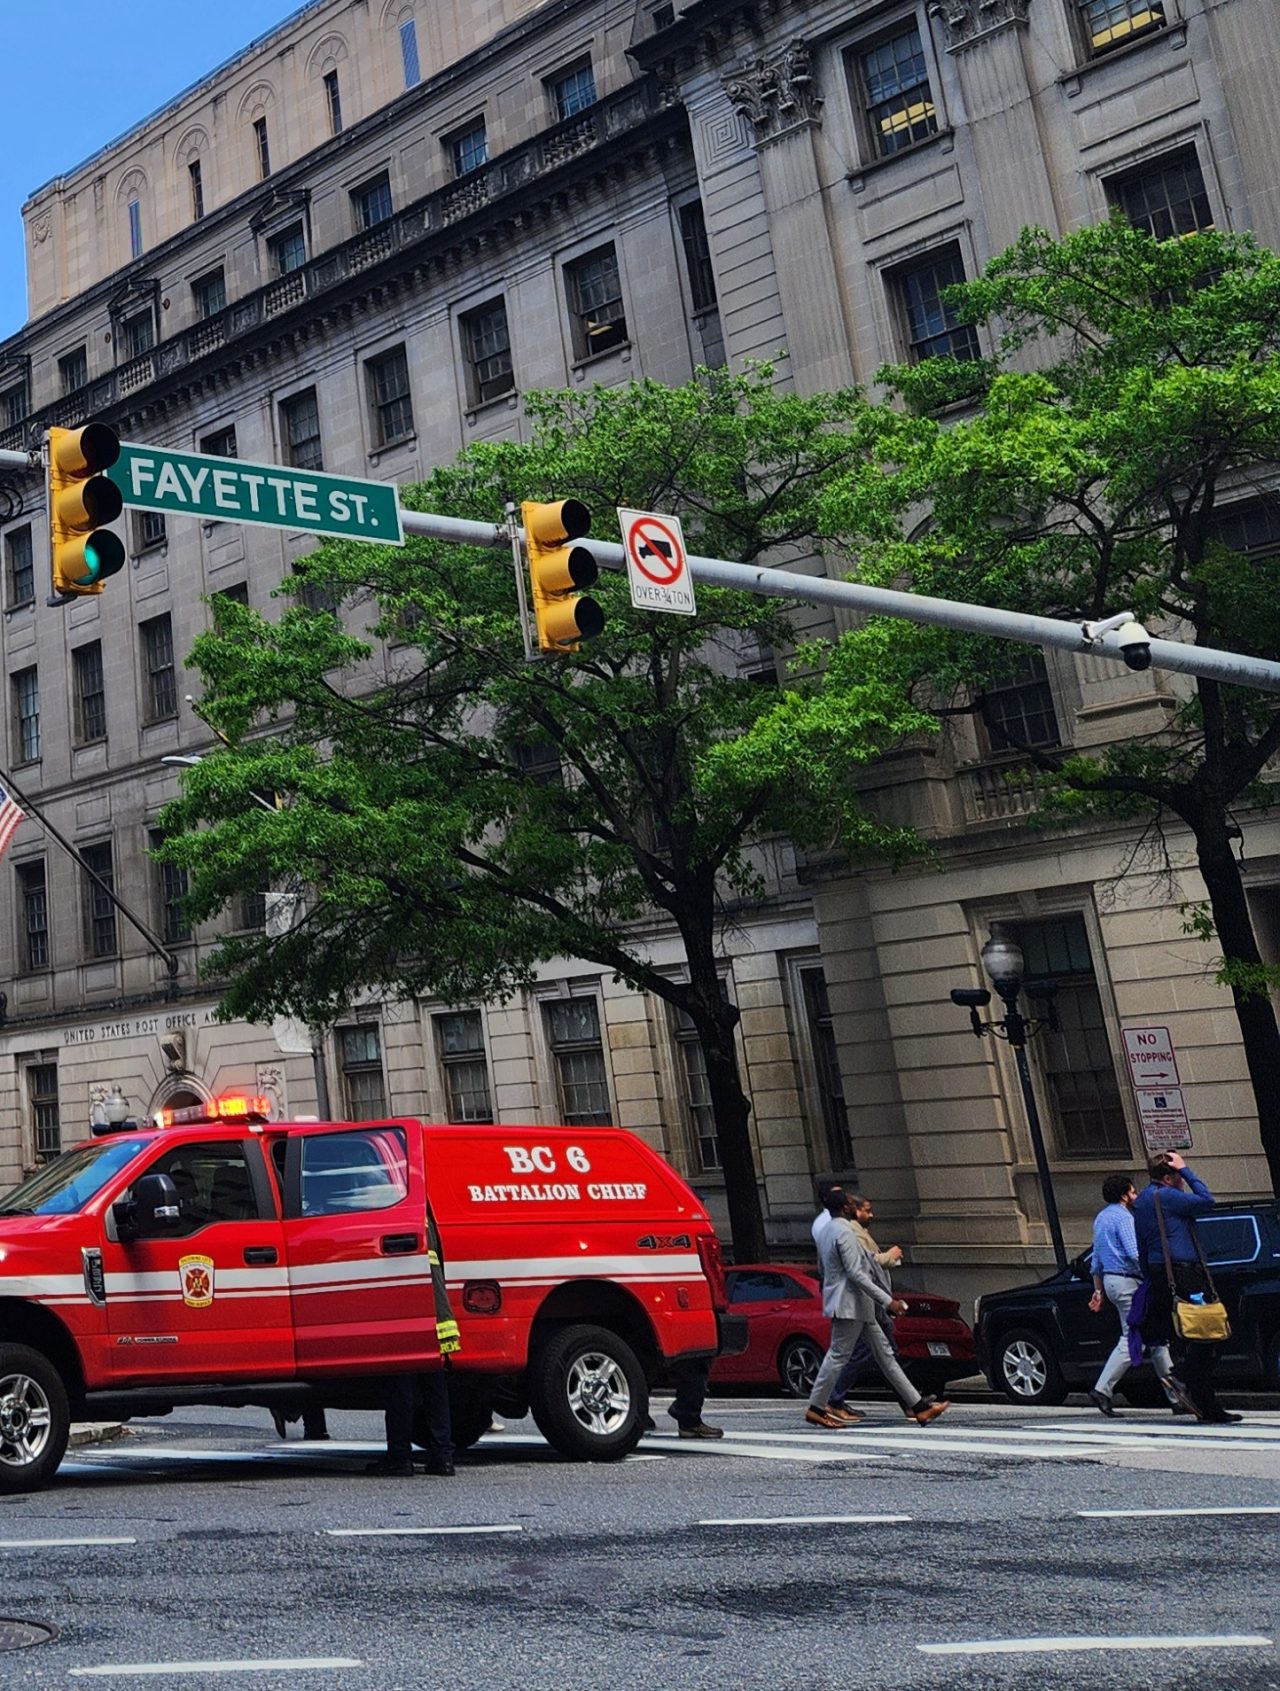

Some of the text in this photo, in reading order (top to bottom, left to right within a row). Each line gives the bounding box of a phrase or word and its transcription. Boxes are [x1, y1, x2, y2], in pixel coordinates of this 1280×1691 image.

[129, 456, 379, 527] FAYETTE ST.
[635, 585, 660, 601] OVER
[672, 590, 691, 605] TON
[63, 1030, 95, 1044] UNITED
[101, 1023, 131, 1038] STATES
[135, 1019, 159, 1033] POST
[165, 1013, 196, 1029] OFFICE
[1136, 1033, 1157, 1045] NO
[1130, 1051, 1173, 1064] STOPPING
[503, 1145, 592, 1174] BC 6
[467, 1183, 647, 1202] BATTALION CHIEF
